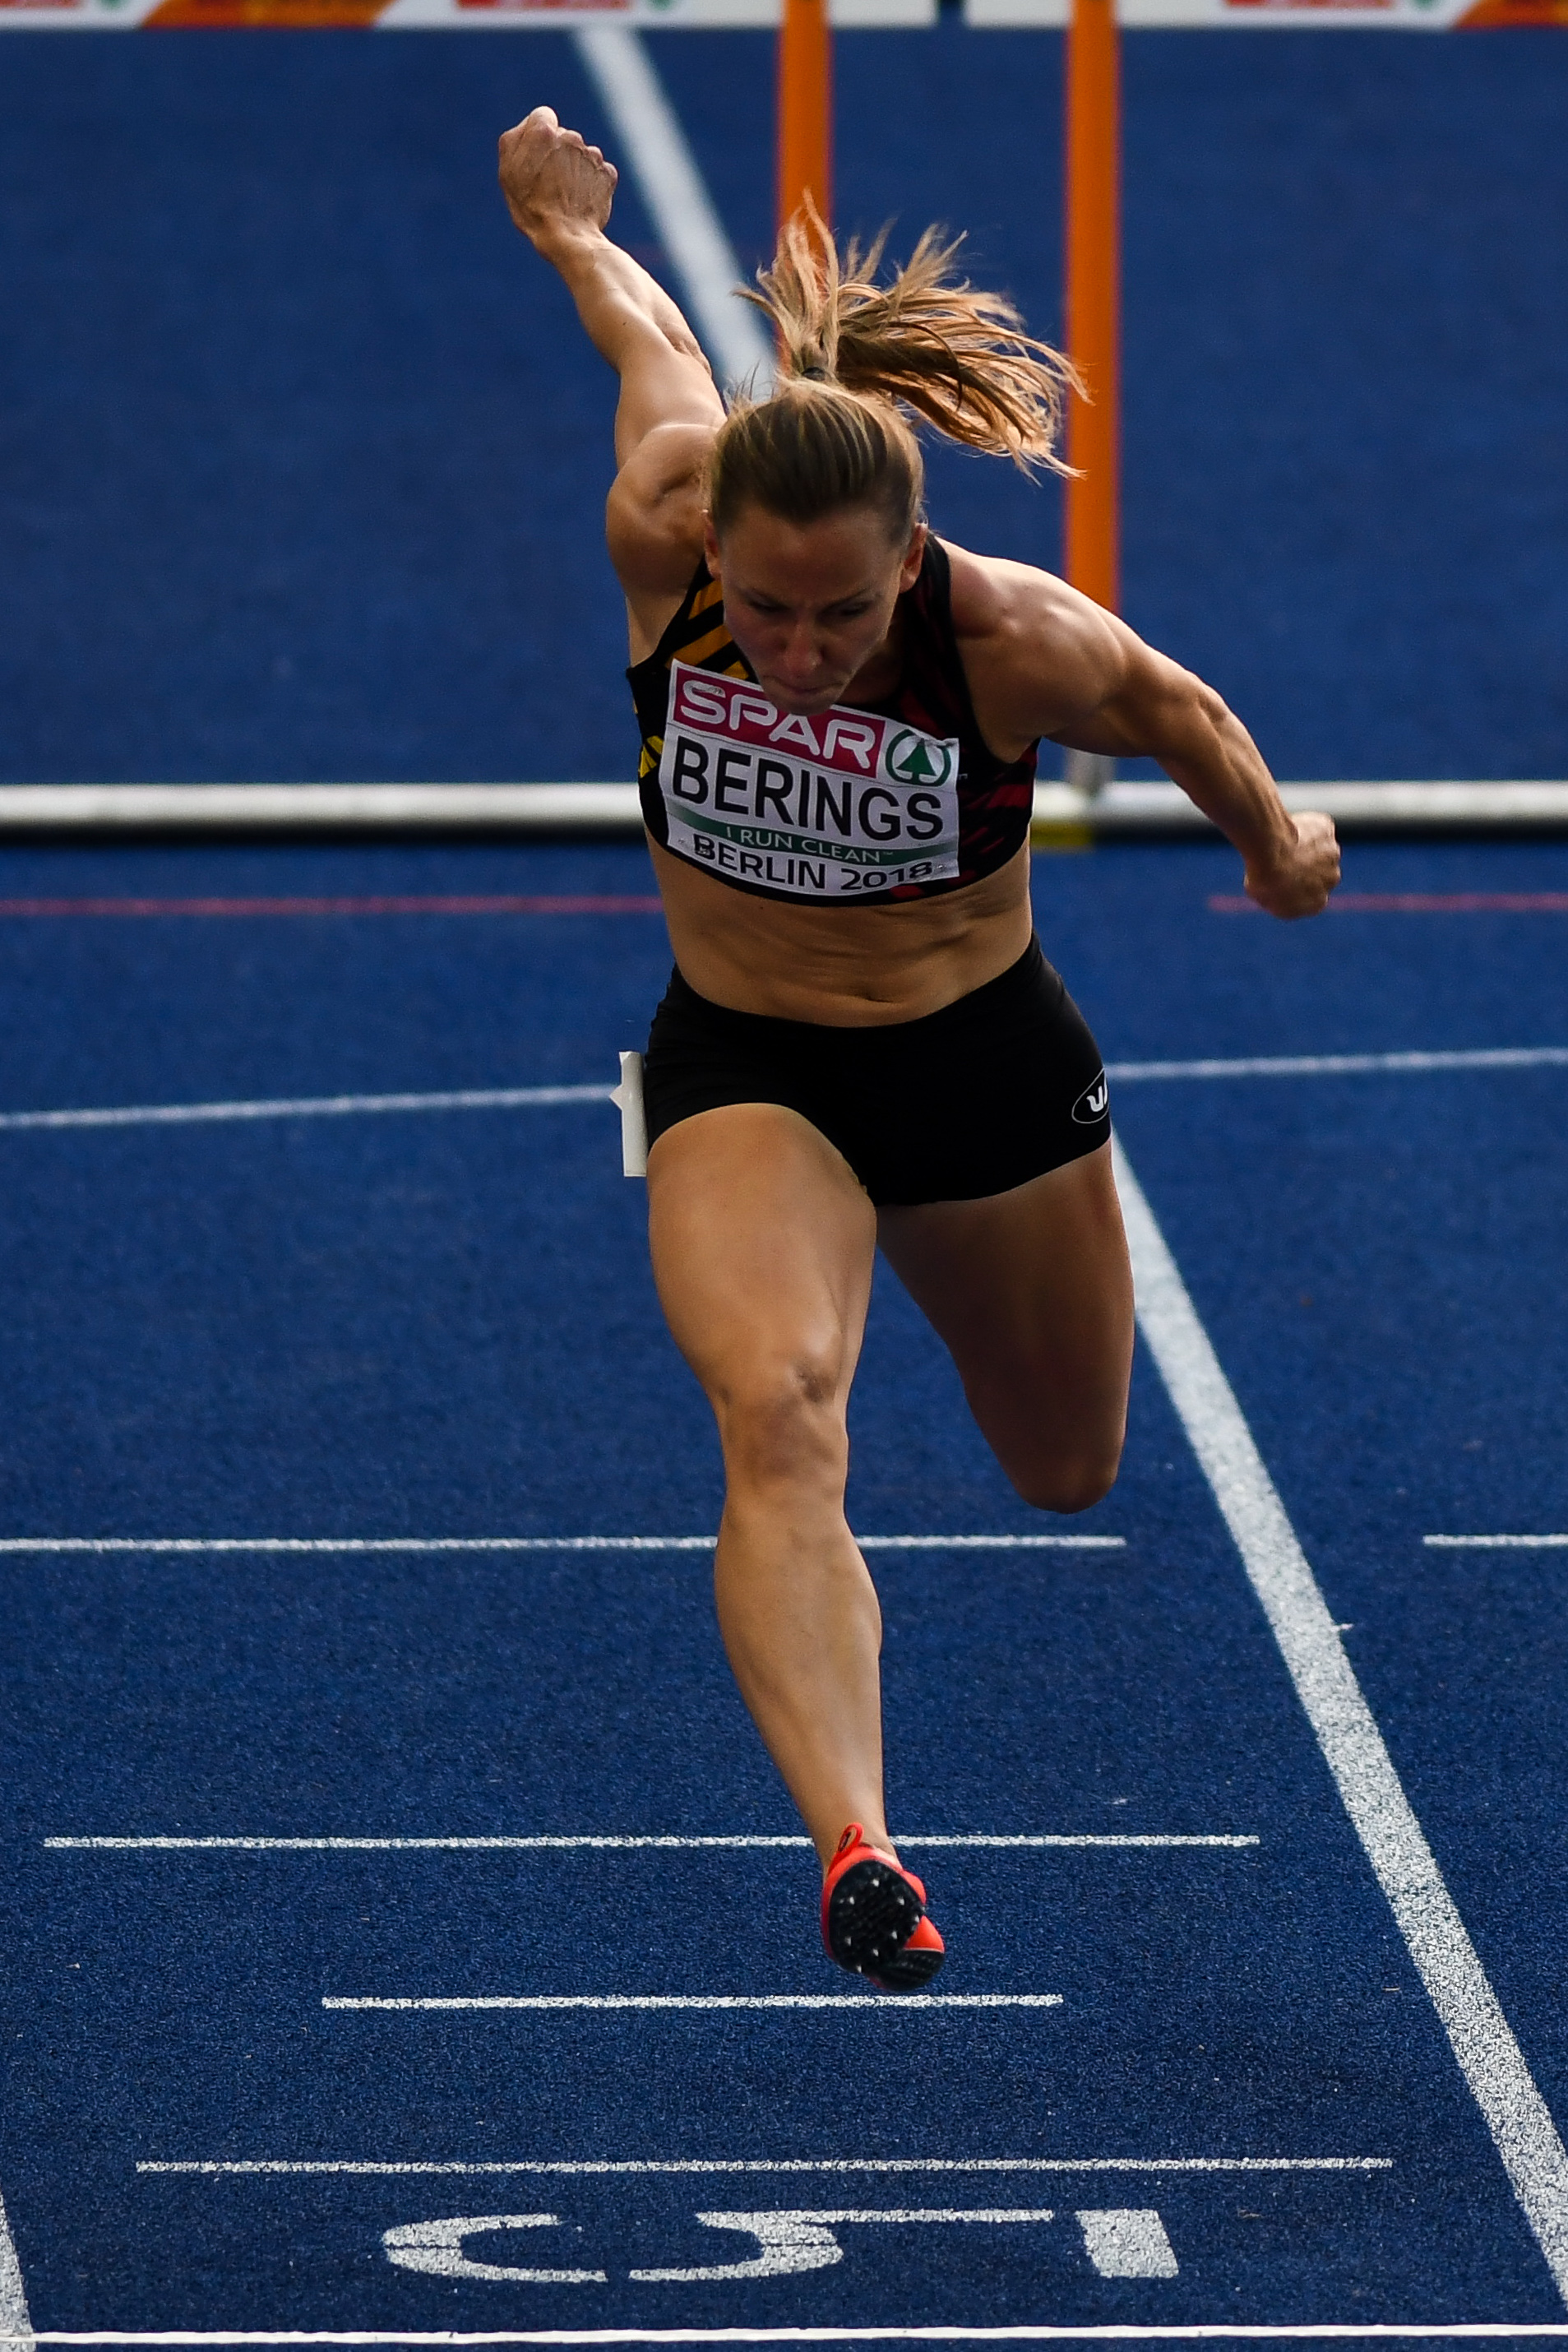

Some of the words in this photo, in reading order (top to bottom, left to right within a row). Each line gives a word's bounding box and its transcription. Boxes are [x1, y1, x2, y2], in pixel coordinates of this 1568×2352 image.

[680, 679, 877, 769] SPAR
[672, 734, 944, 841] BERINGS
[692, 833, 826, 889] BERLIN
[840, 861, 933, 891] 2018
[726, 826, 732, 838] I
[740, 829, 793, 849] RUN
